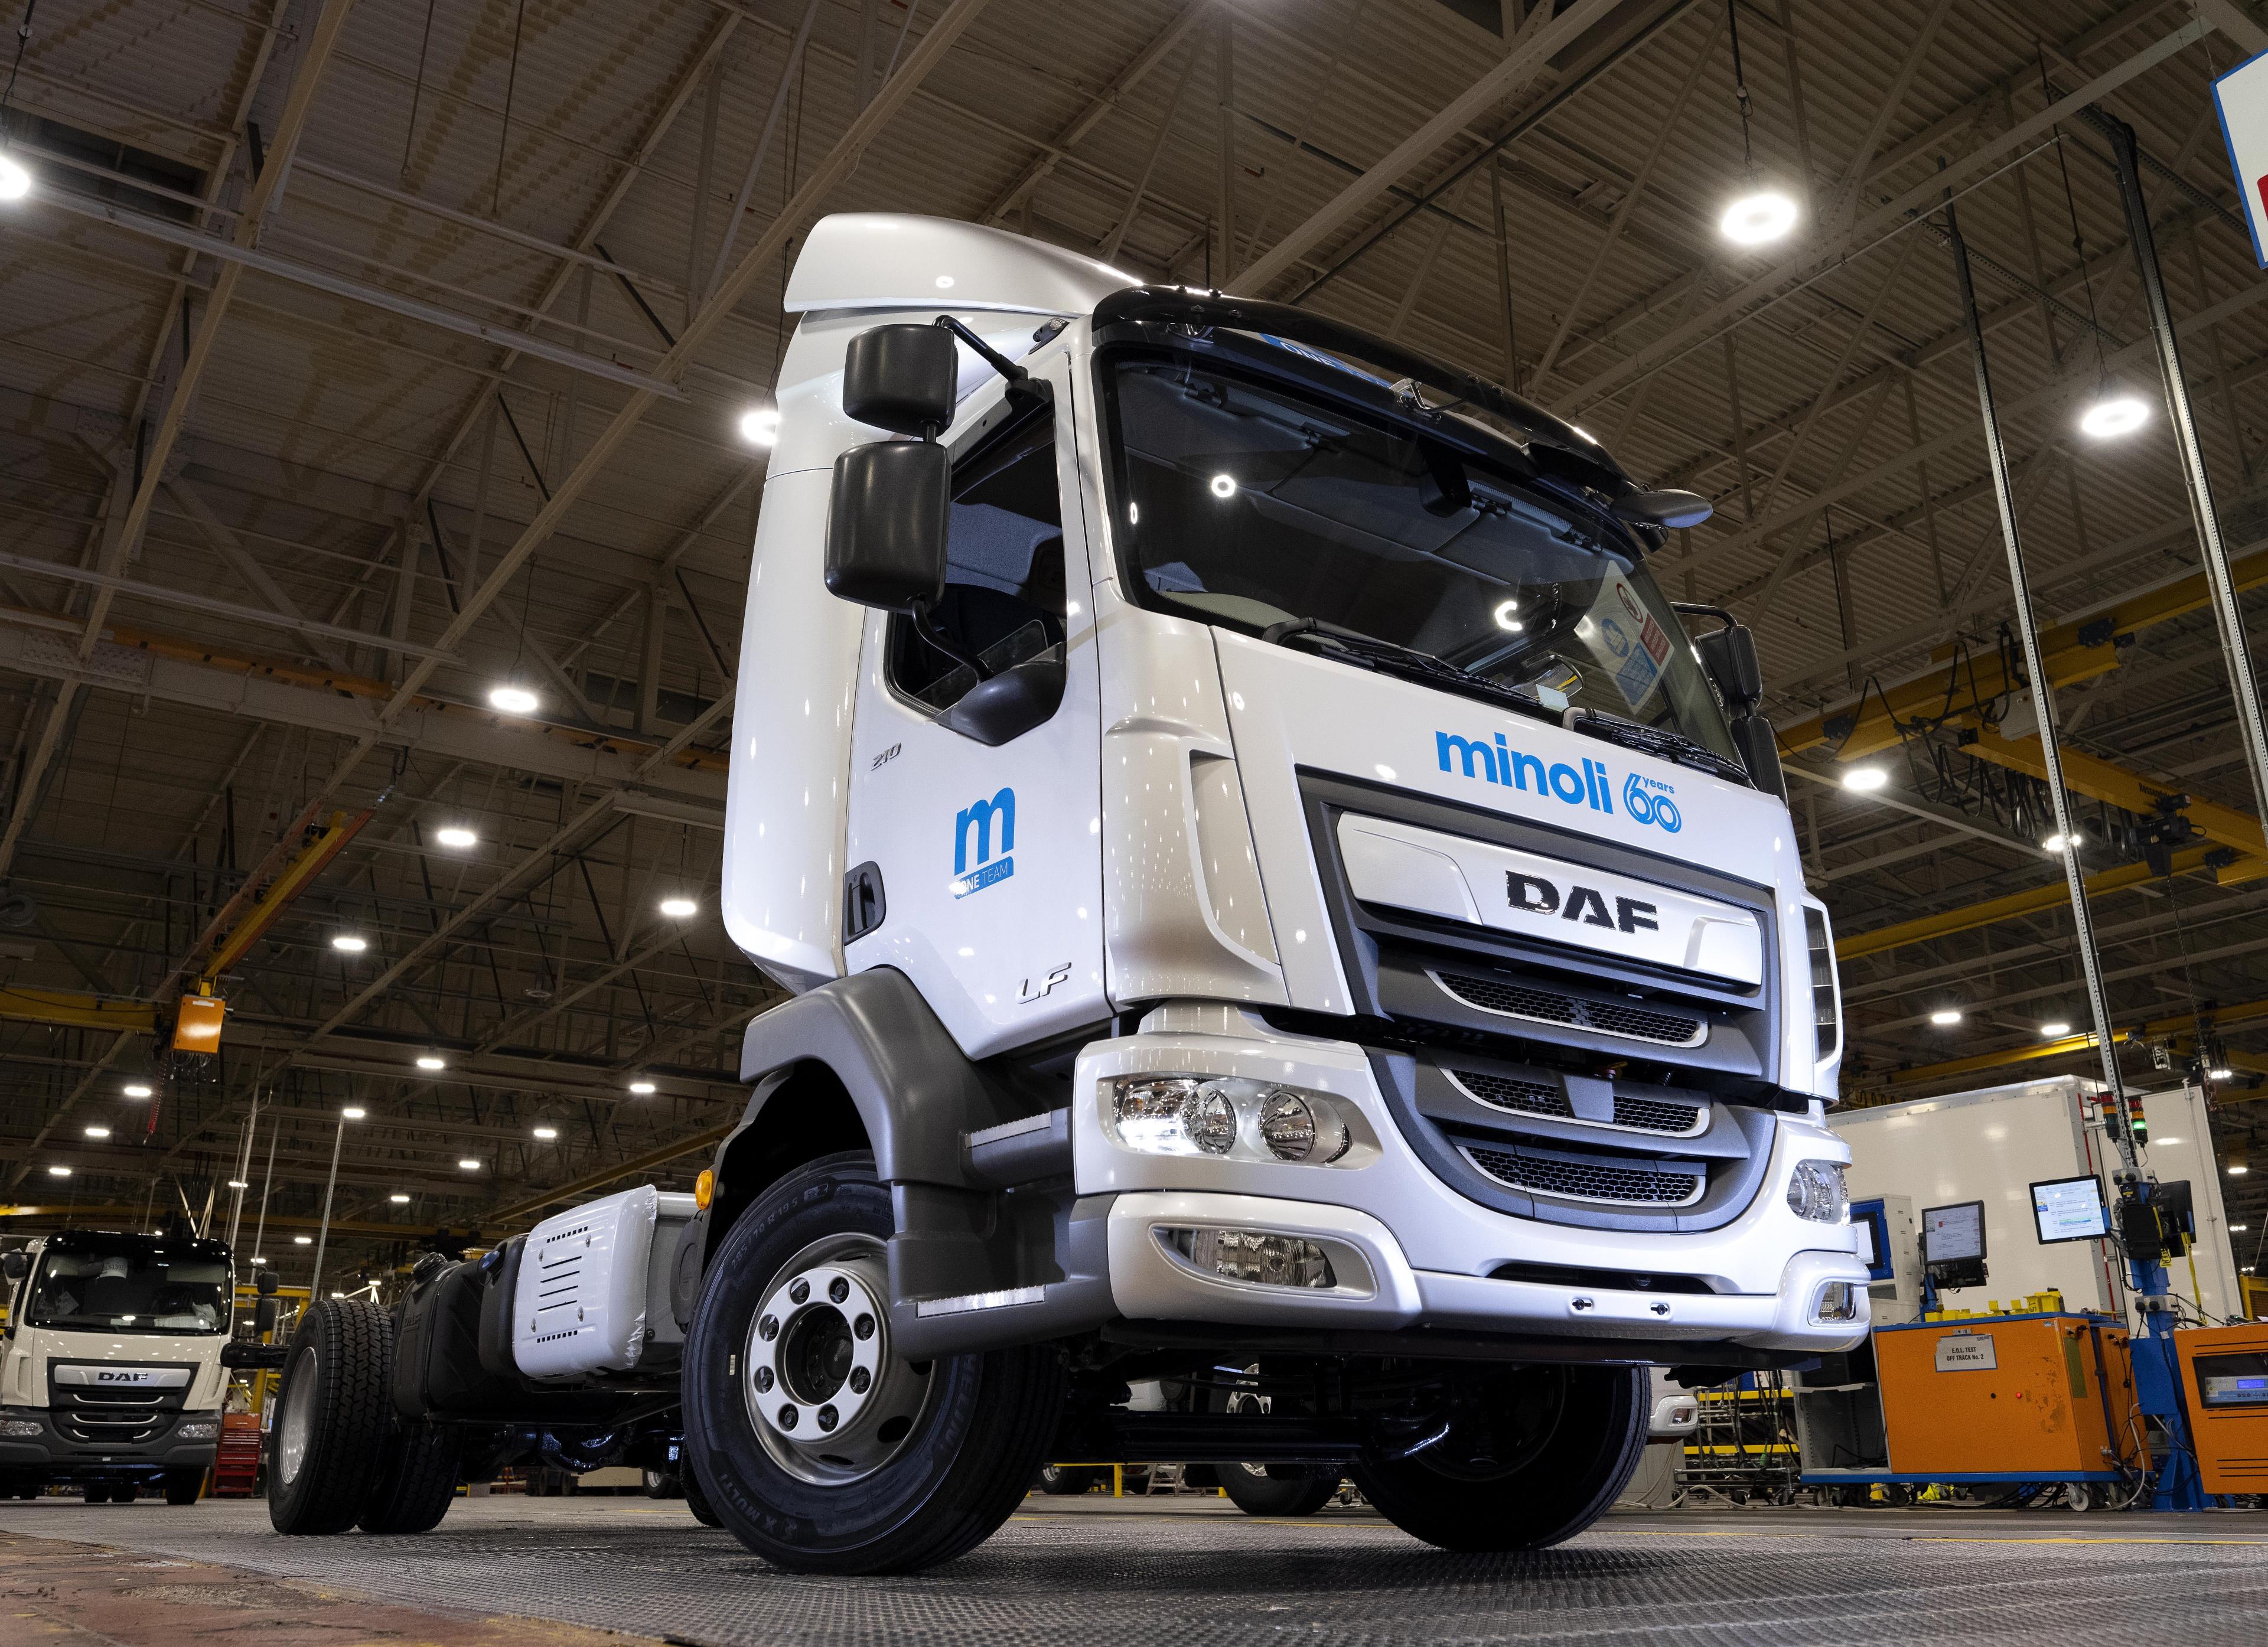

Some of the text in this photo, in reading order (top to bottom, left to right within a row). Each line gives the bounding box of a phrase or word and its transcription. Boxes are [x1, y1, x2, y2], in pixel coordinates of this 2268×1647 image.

[871, 742, 902, 771] 210
[1435, 730, 1614, 815] minoli
[1623, 772, 1682, 833] 60
[1642, 777, 1675, 794] years
[982, 862, 1008, 885] TEAM
[1505, 870, 1660, 935] DAF
[1015, 962, 1072, 1004] LF
[778, 1198, 797, 1215] 195
[97, 1372, 148, 1382] DAF
[718, 1473, 761, 1522] MULTI
